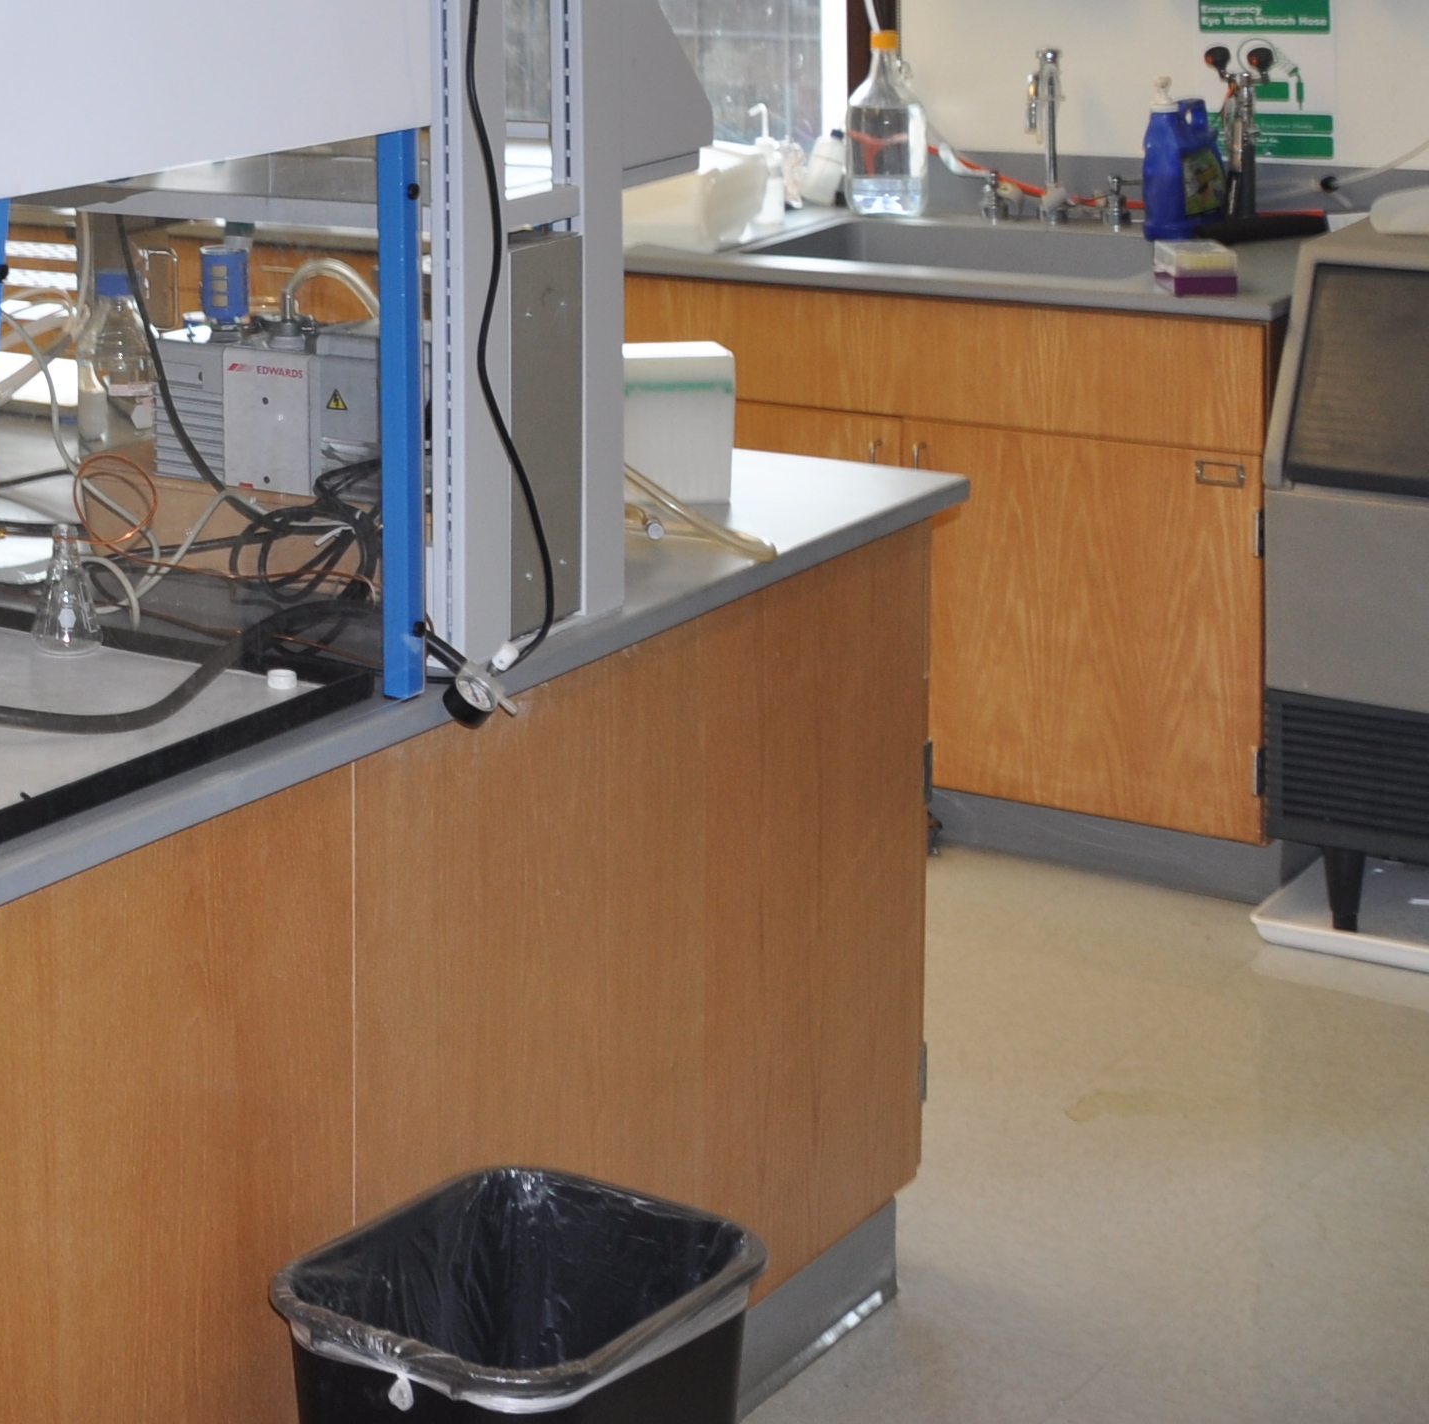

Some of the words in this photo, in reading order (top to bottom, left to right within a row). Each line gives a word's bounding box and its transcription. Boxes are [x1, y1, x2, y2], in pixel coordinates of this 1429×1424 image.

[1201, 5, 1262, 16] Emergency
[1201, 17, 1221, 27] Eye
[1298, 16, 1327, 26] Hose
[256, 365, 304, 379] EDWARDS
